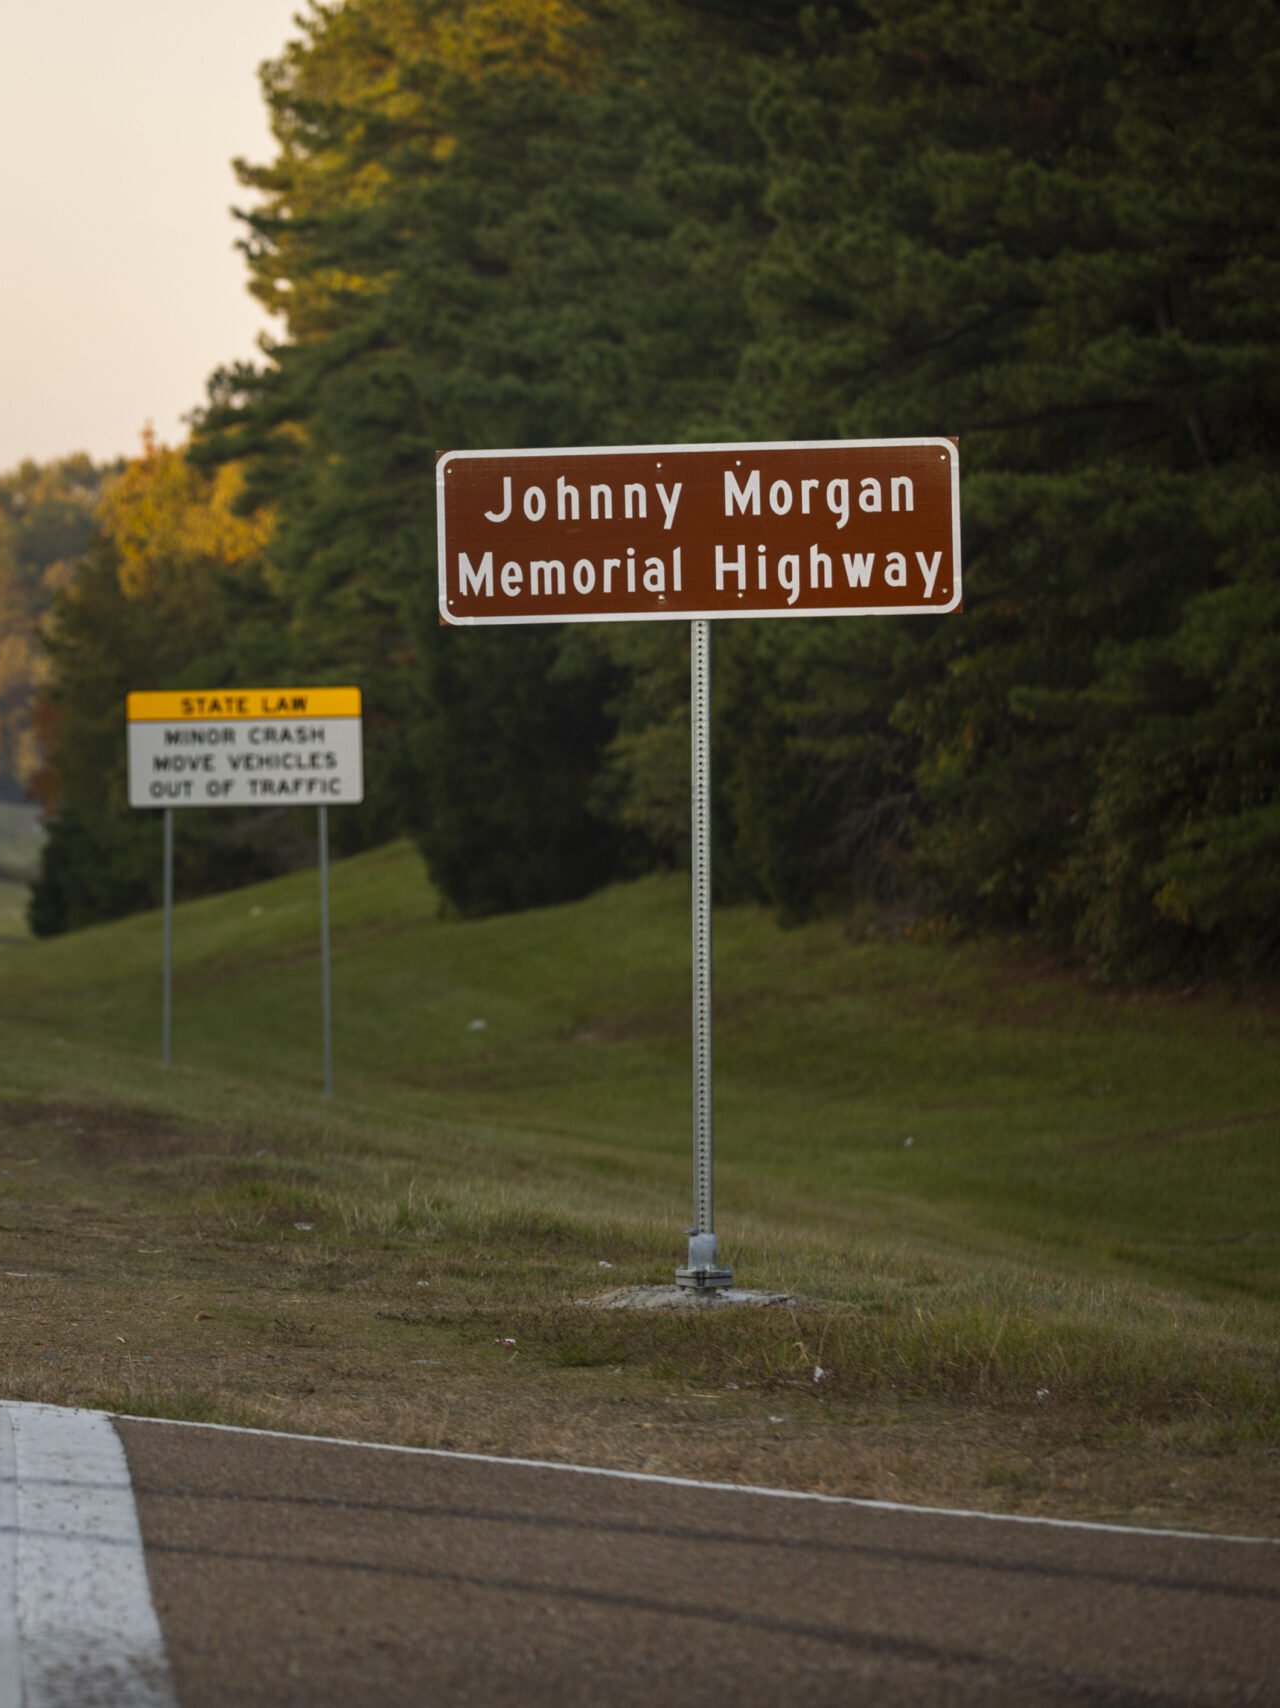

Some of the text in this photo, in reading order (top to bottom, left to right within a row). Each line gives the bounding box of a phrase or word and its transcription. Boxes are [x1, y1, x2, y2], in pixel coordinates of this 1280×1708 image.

[484, 469, 914, 530] Johnny Morgan
[458, 543, 942, 605] Memorial Highway
[181, 696, 308, 715] STATE LAW
[164, 726, 325, 746] MINOR CRASH
[153, 751, 338, 773] MOVE VEHICLES
[149, 777, 342, 799] OUT OF TRAFFIC
